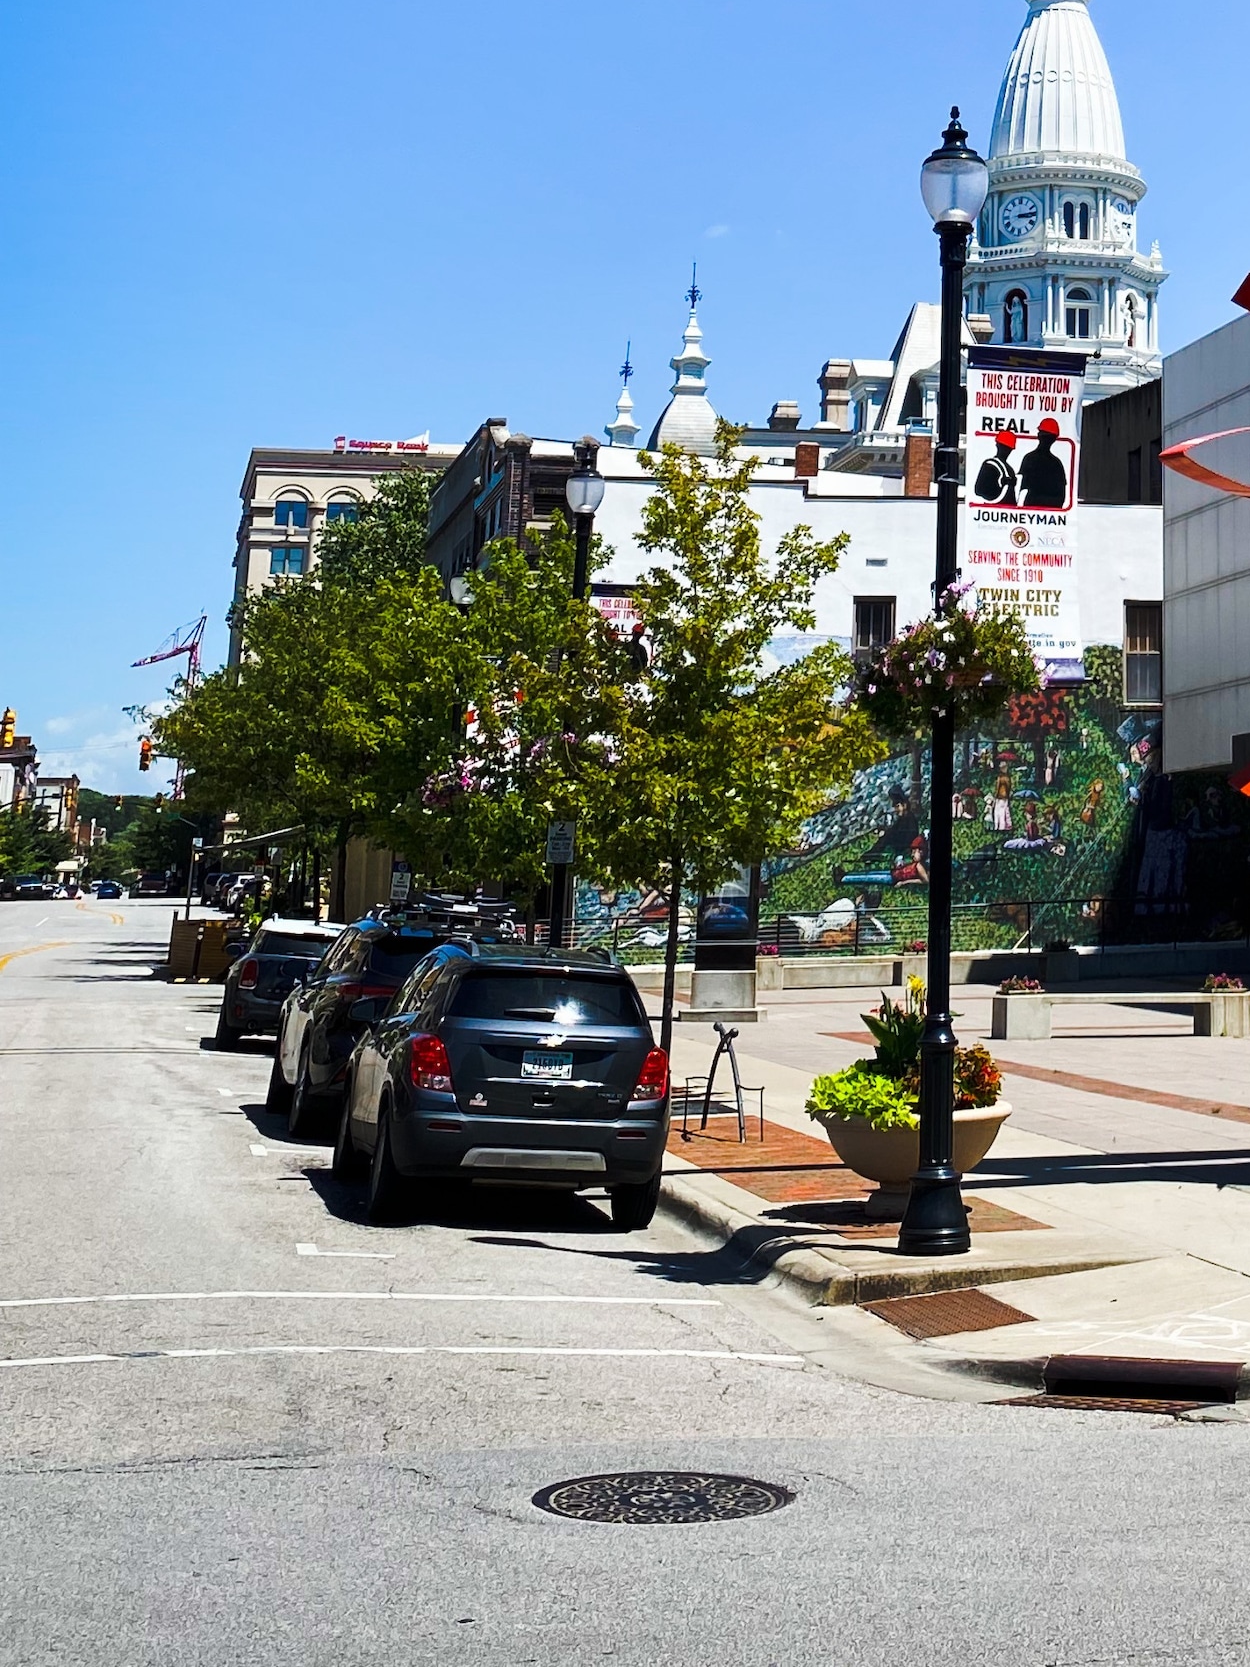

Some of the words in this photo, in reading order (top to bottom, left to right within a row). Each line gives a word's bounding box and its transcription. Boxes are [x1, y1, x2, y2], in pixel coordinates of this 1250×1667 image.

[982, 373, 1003, 390] THIS
[1007, 374, 1070, 394] CELEBRATION
[976, 392, 1018, 410] BROUGHT
[1023, 394, 1034, 411] TO
[1039, 395, 1057, 412] YOU
[1061, 397, 1074, 413] BY
[982, 416, 1030, 434] REAL
[973, 510, 1067, 526] JOURNEYMAN
[968, 550, 1001, 565] SERVING
[1005, 552, 1019, 566] THE
[1022, 553, 1073, 568] COMMUNITY
[997, 568, 1020, 582] SINCE
[1024, 569, 1043, 583] 1910
[979, 587, 1020, 602] TWIN
[1026, 589, 1062, 603] CITY
[982, 602, 1059, 617] ELECTRIC
